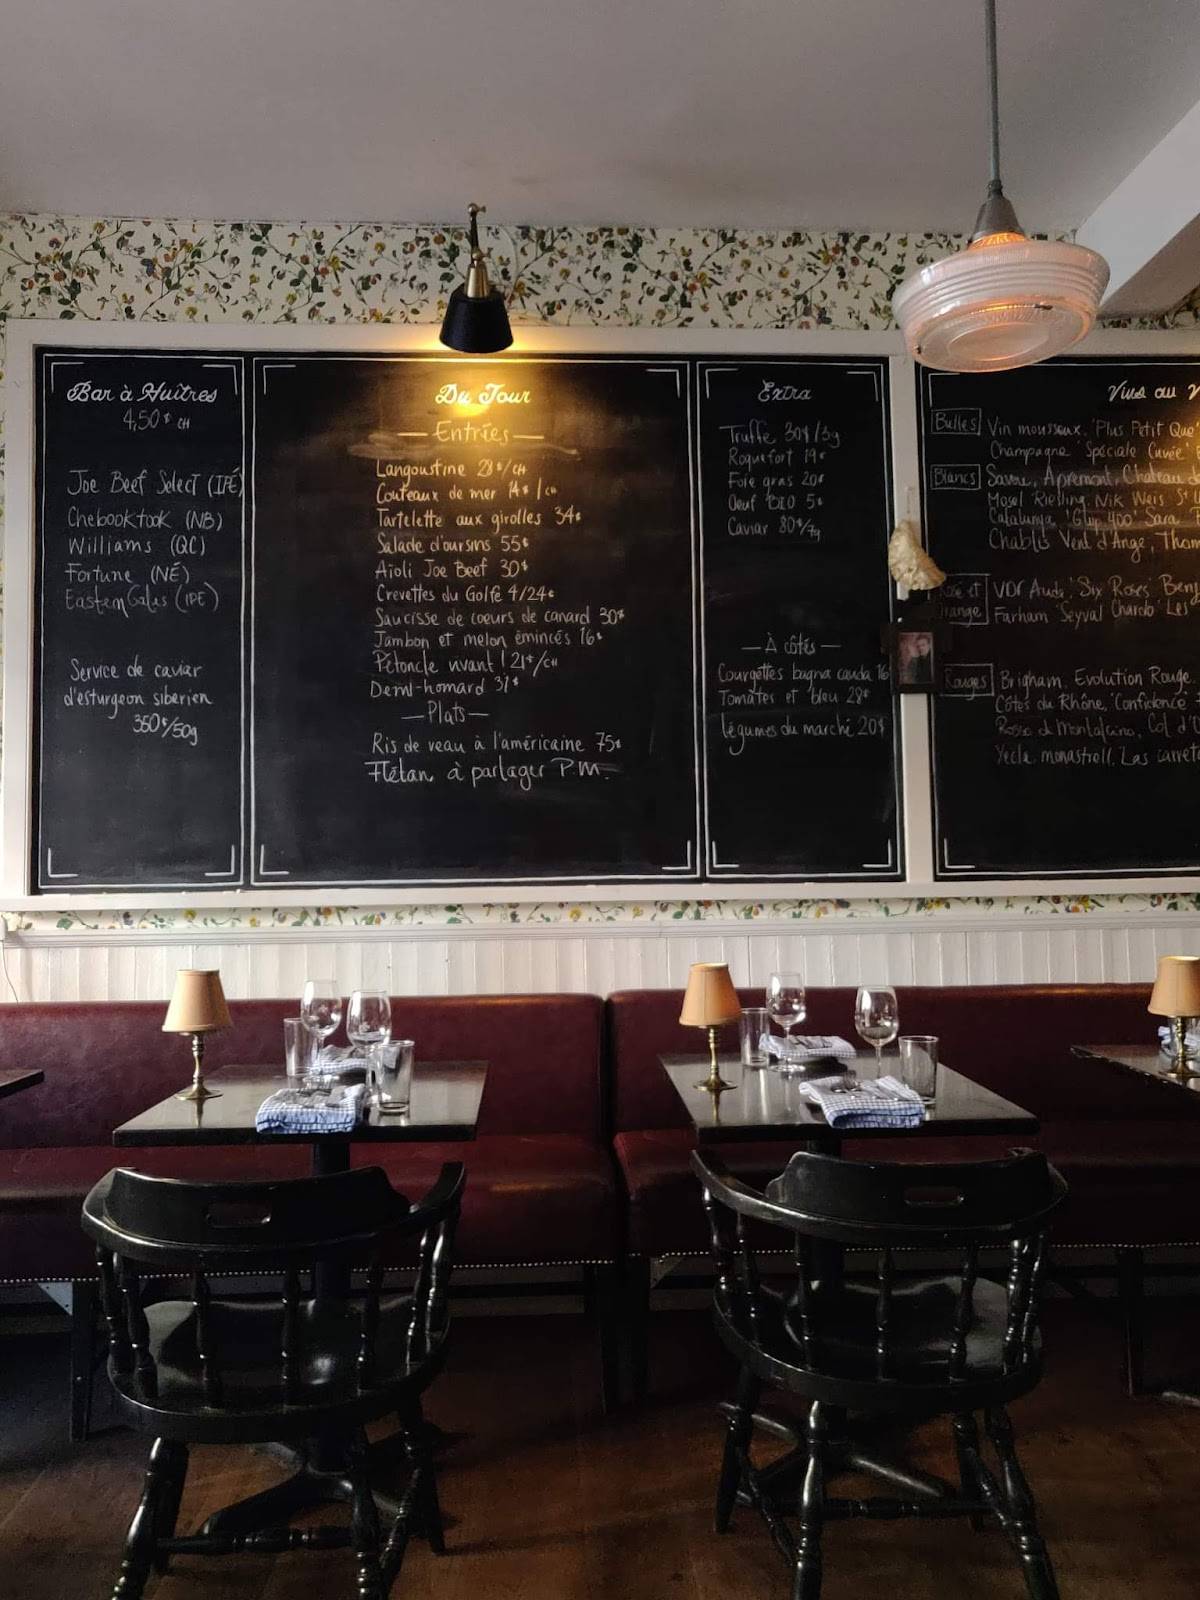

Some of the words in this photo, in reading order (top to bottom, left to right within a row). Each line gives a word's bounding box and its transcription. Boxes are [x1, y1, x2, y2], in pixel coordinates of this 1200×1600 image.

[67, 380, 114, 402] Bar
[119, 385, 134, 402] à
[137, 382, 217, 403] Huîtres
[435, 383, 471, 404] Du
[478, 383, 531, 405] Jour
[758, 380, 812, 402] Extra
[1154, 386, 1176, 399] au
[935, 412, 977, 431] Bulles
[987, 415, 1012, 437] Vin
[1131, 420, 1164, 438] Petit
[729, 447, 792, 472] Roquefort
[990, 440, 1071, 465] Champagne
[67, 470, 99, 495] Joe
[110, 469, 148, 496] Beef
[156, 469, 201, 496] Select
[376, 459, 467, 487] Langoustine
[934, 467, 976, 485] Blancs
[376, 483, 439, 505] Couteaux
[449, 486, 463, 500] de
[470, 489, 496, 501] mer
[728, 472, 755, 489] Foie
[763, 475, 792, 499] gras
[728, 494, 756, 512] Oeuf
[1094, 491, 1124, 508] Nik
[67, 505, 171, 529] Chebooktook
[186, 509, 223, 531] (NB)
[376, 508, 444, 528] Tartelette
[456, 514, 483, 526] aux
[491, 509, 541, 535] girolles
[728, 516, 768, 536] Caviar
[69, 536, 151, 556] Williams
[170, 534, 205, 556] (QC)
[377, 533, 425, 554] Salade
[430, 534, 491, 552] d'oursins
[989, 528, 1050, 553] Chablis
[64, 563, 133, 583] Fortune
[151, 562, 190, 585] (NÉ)
[423, 558, 448, 578] Joe
[456, 558, 488, 578] Beef
[376, 584, 435, 603] Crevettes
[442, 586, 458, 602] du
[466, 584, 503, 603] Golfe
[375, 607, 440, 627] Saucisse
[447, 608, 464, 626] de
[471, 611, 514, 625] coeurs
[521, 608, 537, 623] de
[544, 605, 590, 623] canard
[374, 630, 430, 650] Jambon
[439, 631, 455, 648] et
[463, 632, 507, 648] melon
[70, 658, 119, 682] Service
[127, 655, 144, 677] de
[154, 661, 203, 678] caviar
[718, 662, 783, 690] Courgettes
[371, 679, 485, 699] Demi-homard
[786, 689, 799, 704] et
[810, 688, 838, 705] bleu
[64, 687, 144, 719] d'esturgeon
[428, 701, 466, 725] Plats
[995, 694, 1030, 713] Côtes
[1037, 693, 1055, 710] du
[781, 714, 799, 736] du
[803, 714, 854, 737] marché
[372, 732, 397, 754] Ris
[404, 735, 420, 753] de
[428, 740, 466, 753] veau
[474, 740, 484, 752] à
[493, 730, 585, 752] l'américaine
[447, 761, 464, 780] à
[471, 755, 544, 791] partager
